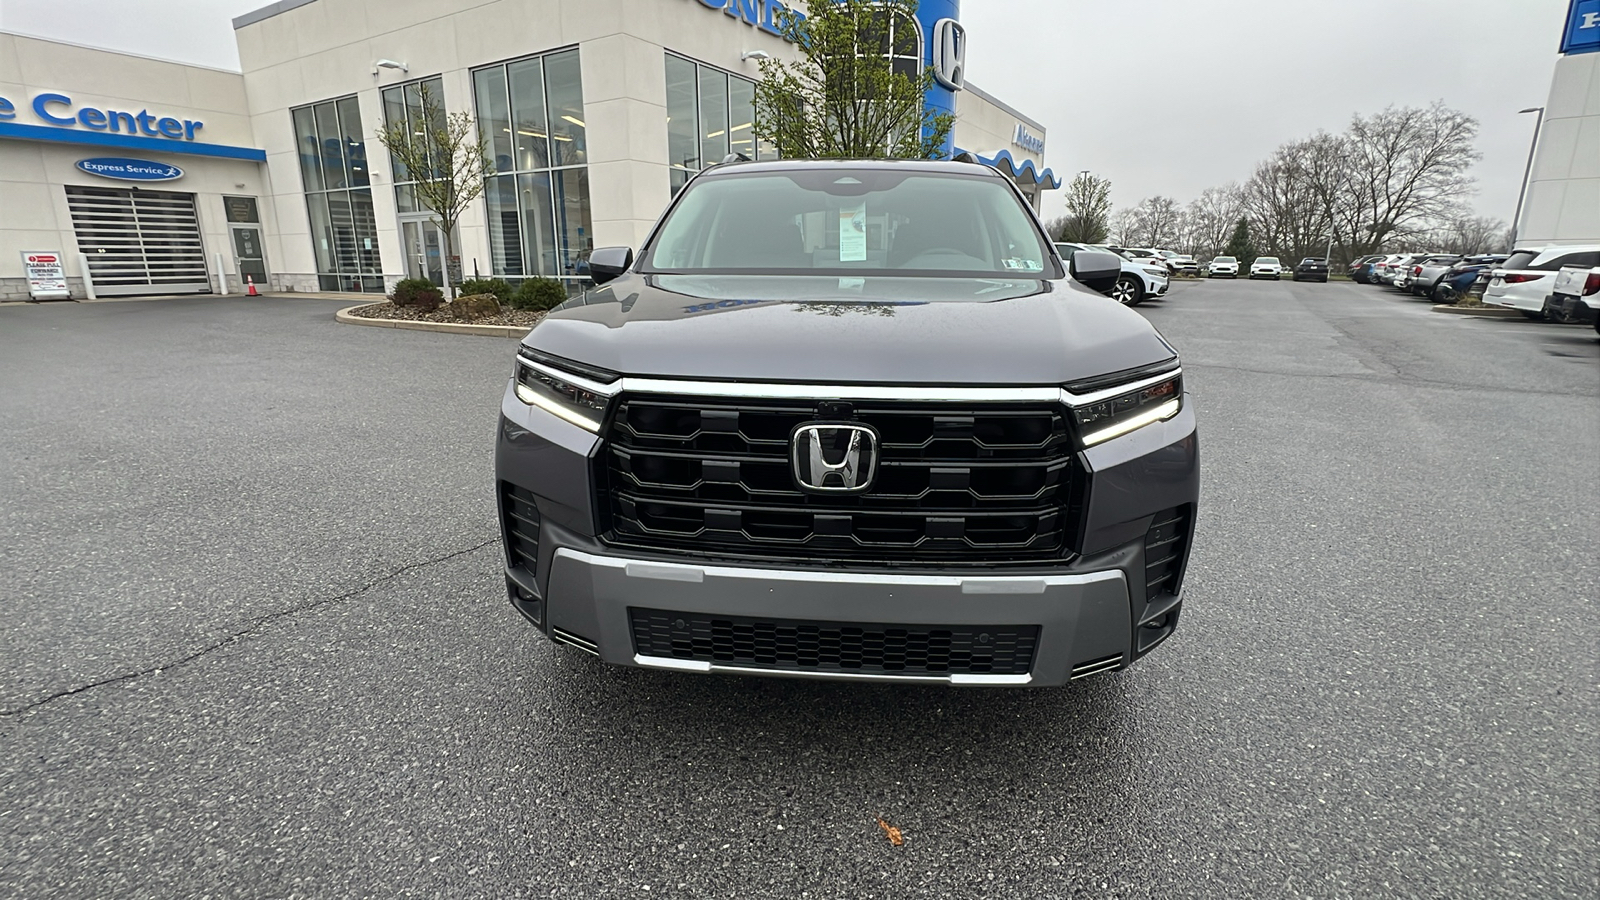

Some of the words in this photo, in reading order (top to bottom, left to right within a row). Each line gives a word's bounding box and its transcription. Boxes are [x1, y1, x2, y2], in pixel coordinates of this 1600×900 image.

[32, 93, 203, 140] Center
[83, 161, 125, 172] Express
[126, 165, 163, 175] Service
